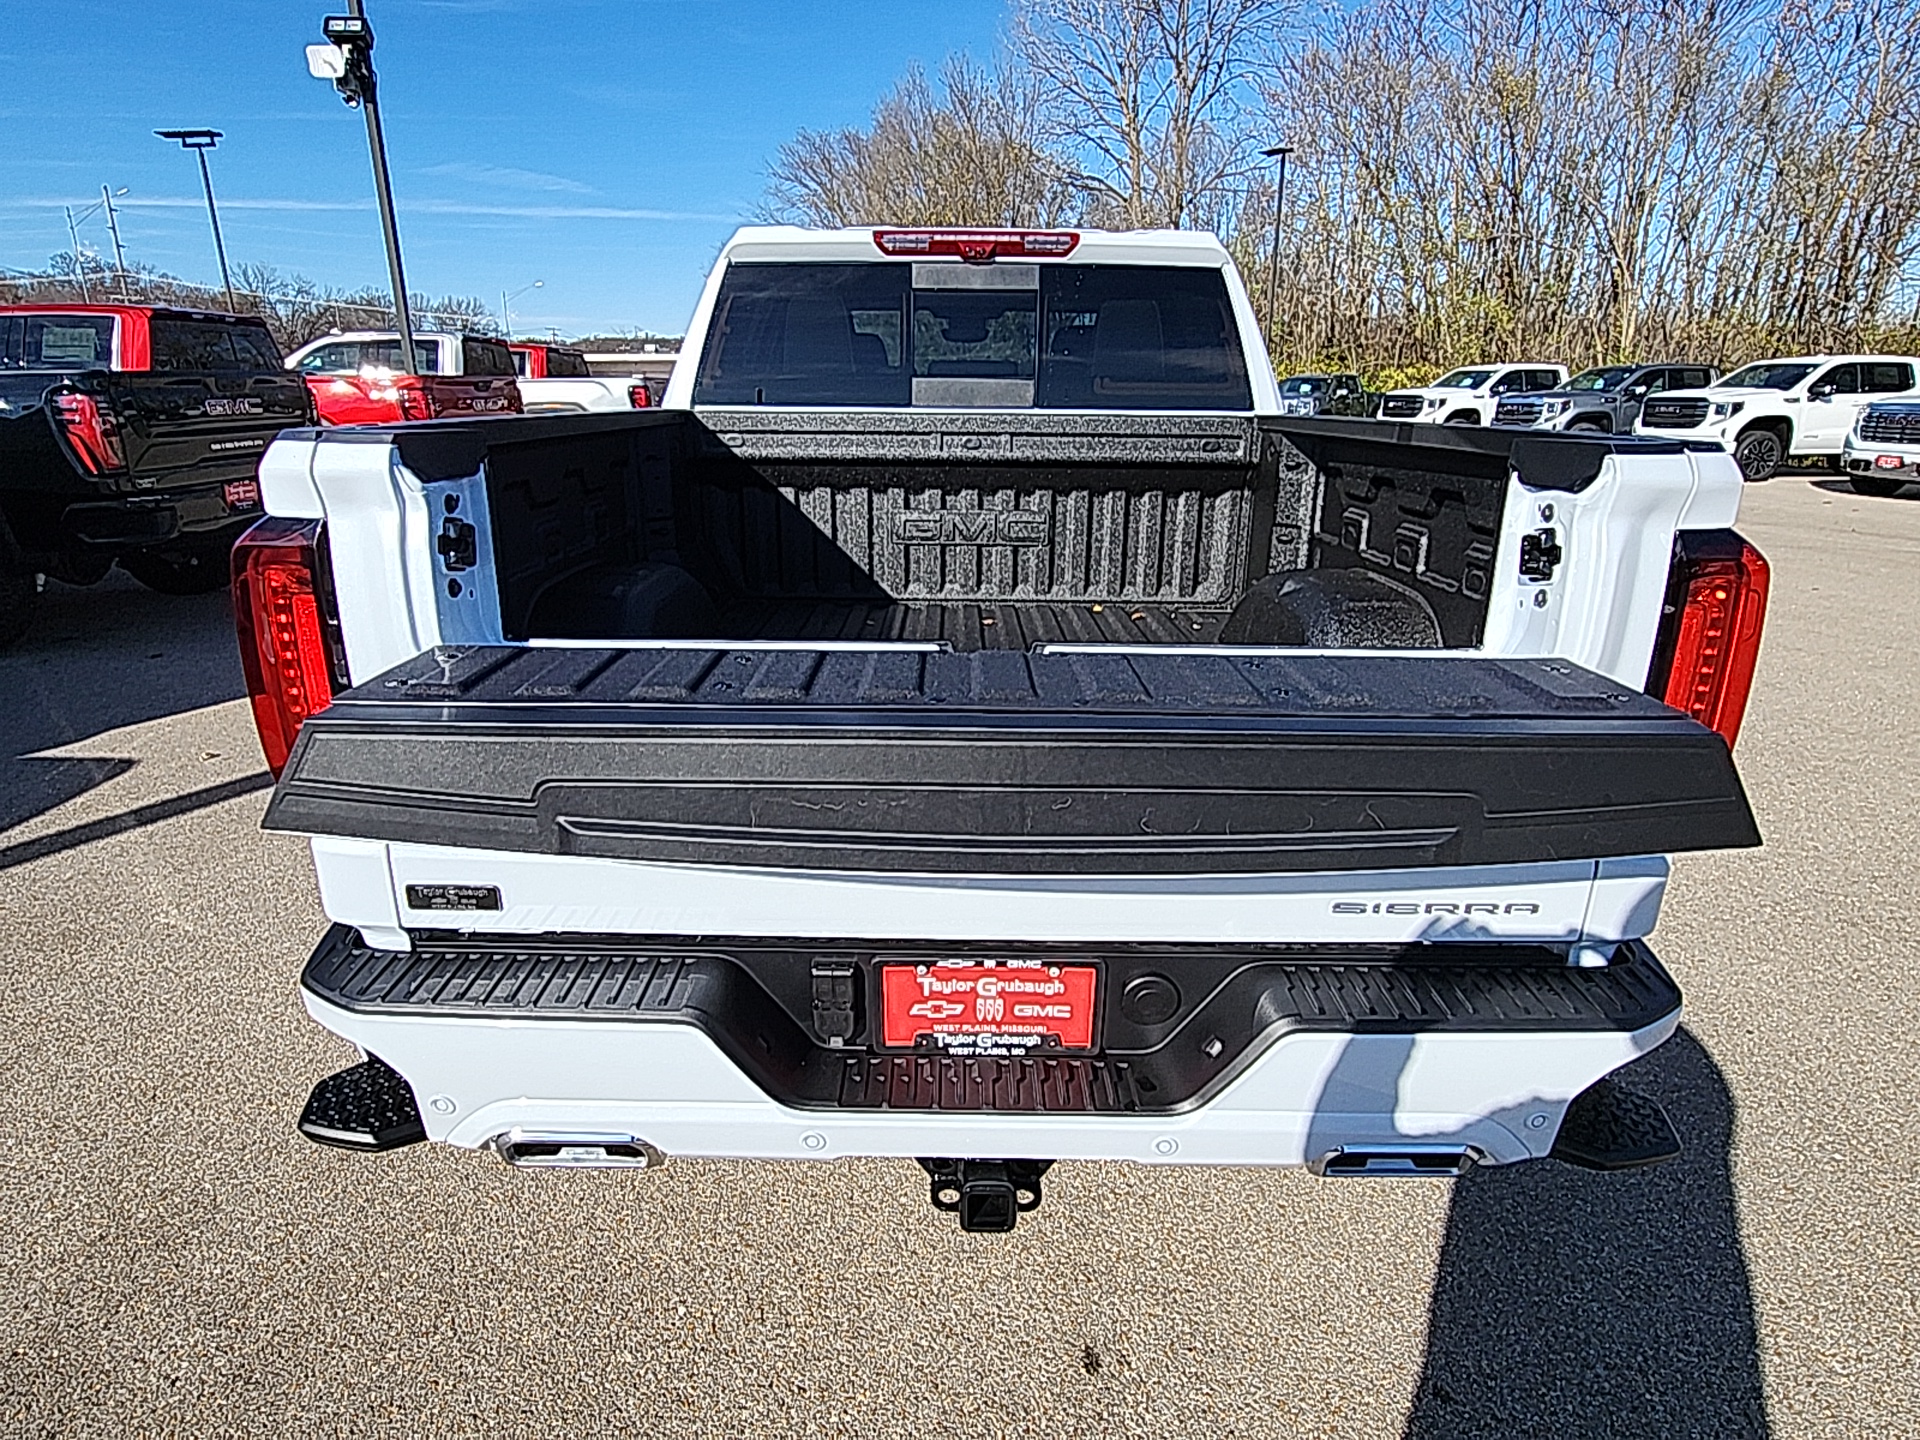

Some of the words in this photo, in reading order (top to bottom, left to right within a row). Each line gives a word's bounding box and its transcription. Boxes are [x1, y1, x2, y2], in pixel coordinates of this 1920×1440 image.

[889, 509, 1049, 546] GMC
[1331, 902, 1540, 915] SIERRA
[1006, 959, 1042, 969] GMC
[916, 976, 974, 997] Taylor
[976, 977, 1065, 996] Grubaugh
[1013, 1004, 1072, 1018] GMC
[933, 1024, 959, 1032] WEST
[962, 1024, 999, 1033] PLAINS,
[1001, 1025, 1047, 1033] MISSOURI
[933, 1033, 975, 1047] Taylor
[976, 1033, 1041, 1047] Grubaugh
[948, 1047, 974, 1056] WEST
[975, 1047, 1009, 1056] PLAINS,
[1011, 1048, 1026, 1056] MO
